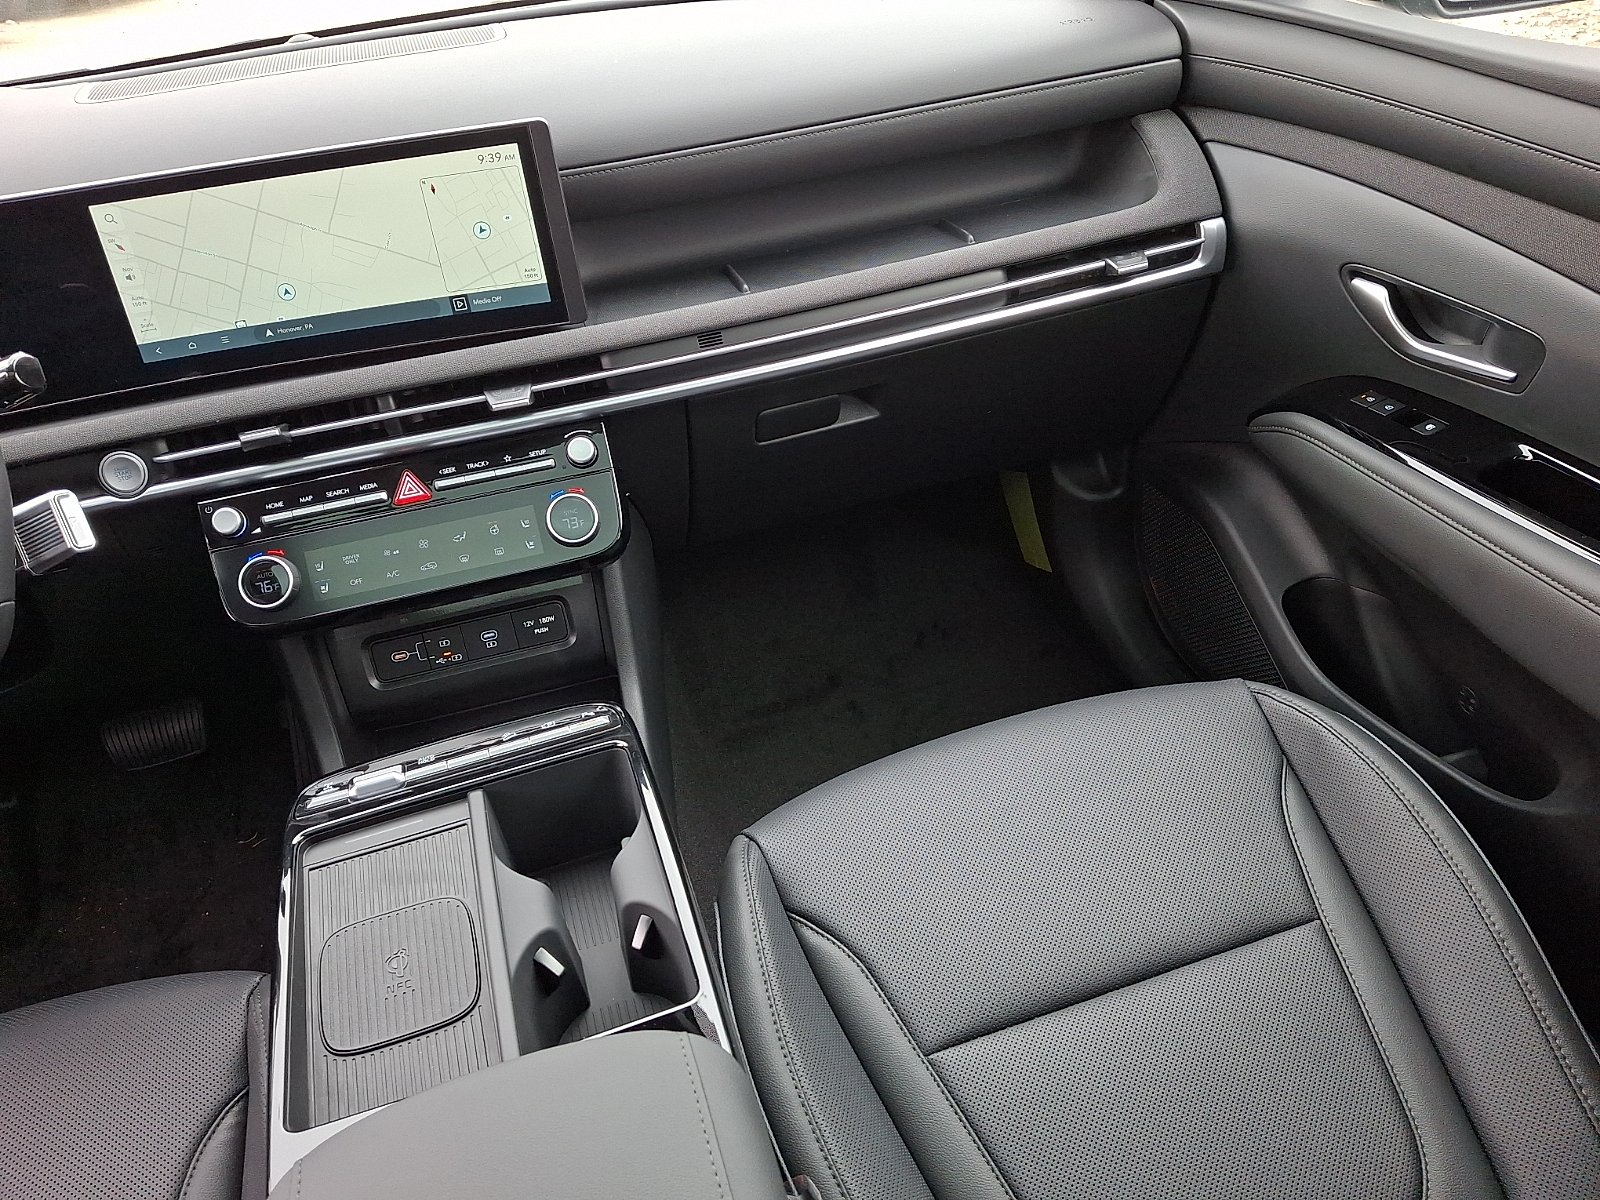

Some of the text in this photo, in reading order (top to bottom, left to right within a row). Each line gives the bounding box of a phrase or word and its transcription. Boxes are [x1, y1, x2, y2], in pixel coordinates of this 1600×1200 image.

[477, 152, 502, 164] 9:39
[473, 295, 502, 305] Media Off
[528, 449, 547, 458] SETUP
[359, 482, 378, 491] MEDIA
[325, 488, 350, 498] SEARCH
[299, 495, 313, 503] MAP
[265, 501, 285, 510] HOME
[256, 571, 274, 580] AUTO
[386, 569, 400, 578] A/C
[349, 577, 363, 586] OFF
[523, 615, 555, 628] 12V 180W
[534, 627, 549, 635] PUSH
[386, 979, 412, 994] NFC
